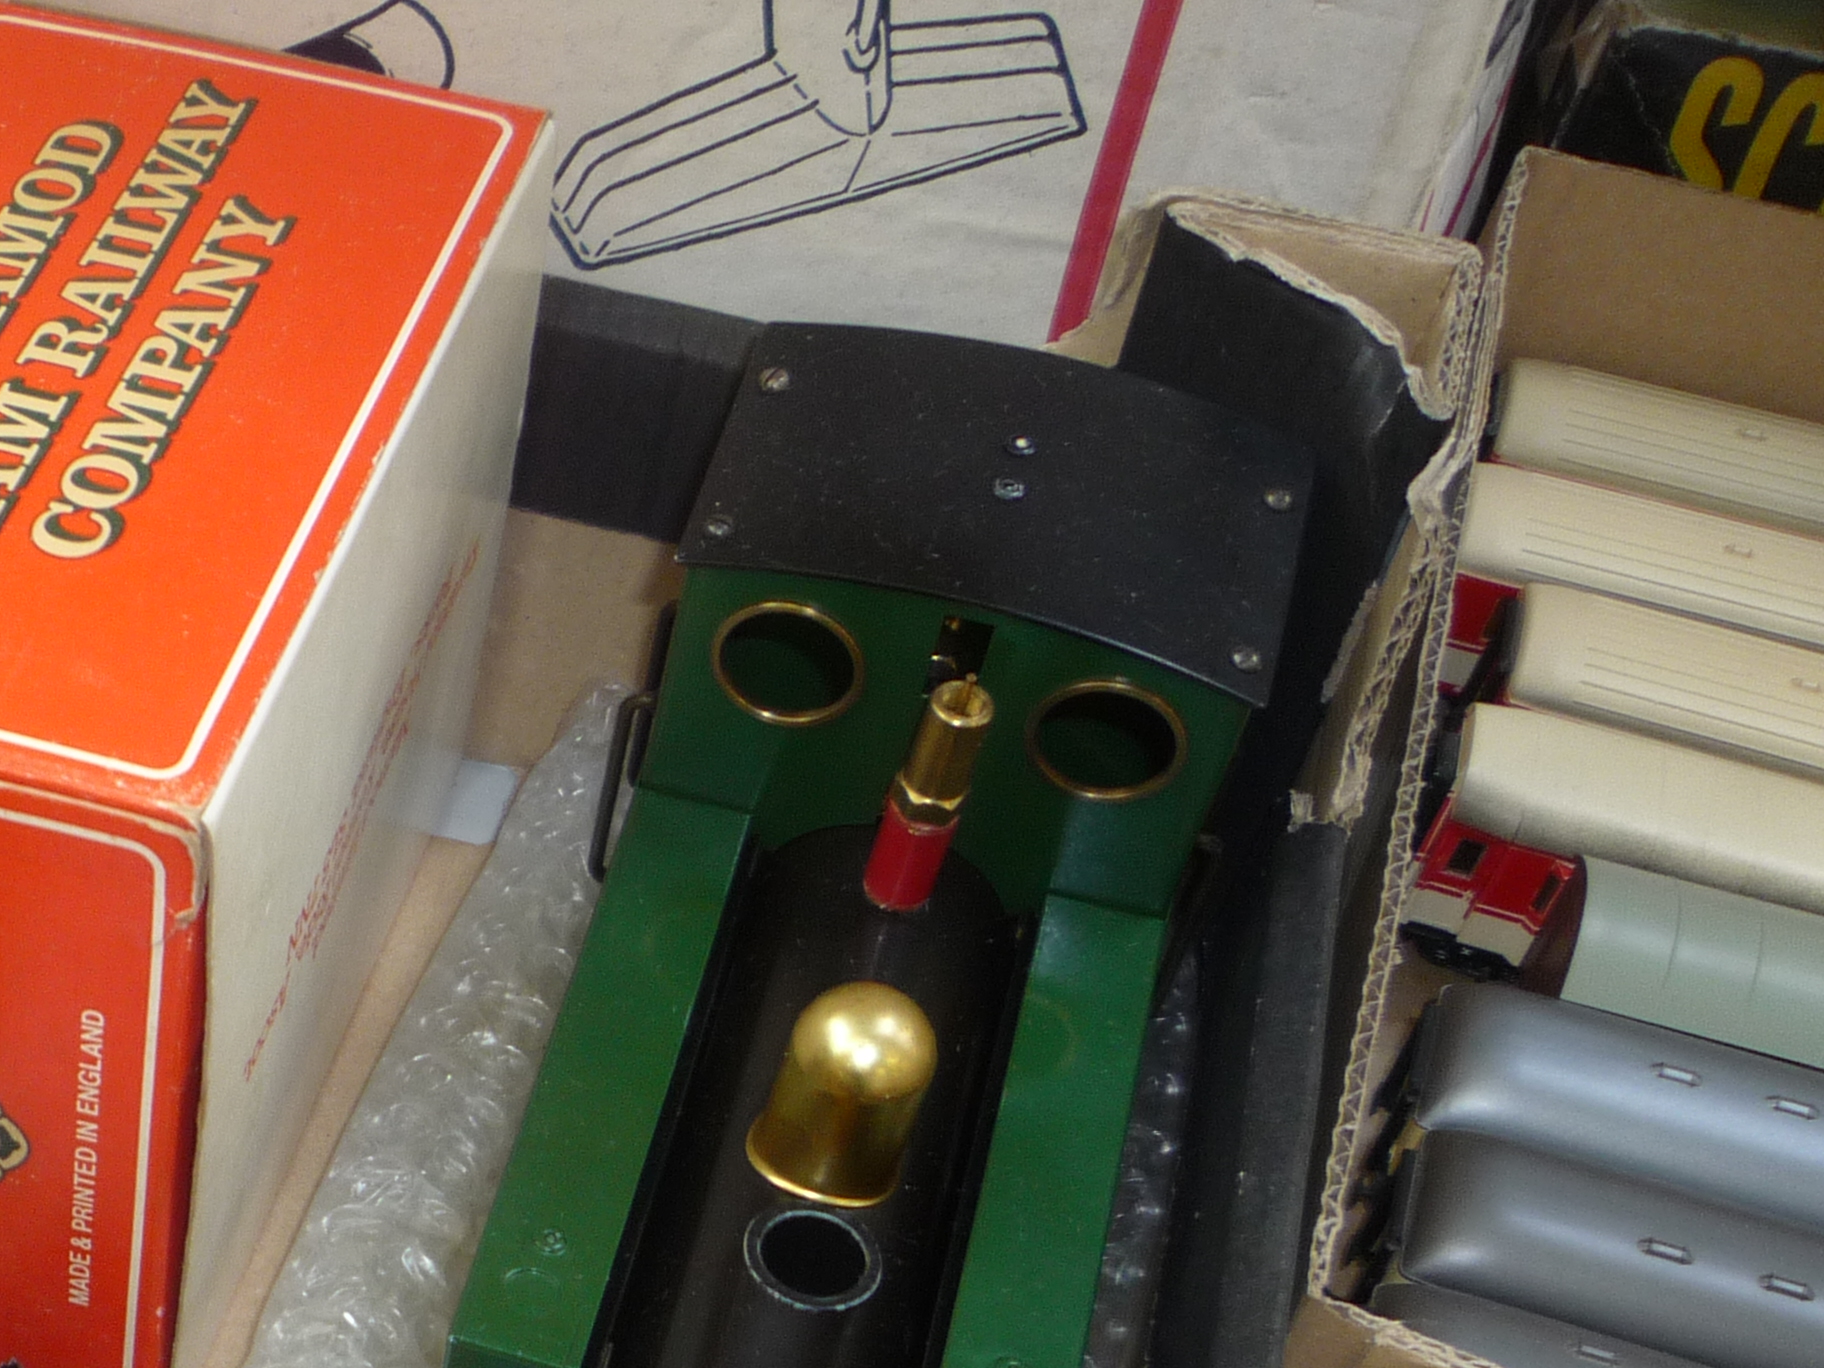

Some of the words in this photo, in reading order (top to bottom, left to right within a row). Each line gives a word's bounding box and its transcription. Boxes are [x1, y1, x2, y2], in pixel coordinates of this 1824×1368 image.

[16, 79, 259, 379] RAILWAY
[31, 196, 298, 559] COMPANY
[77, 1009, 105, 1117] ENGLAND
[76, 1119, 98, 1143] IN
[72, 1149, 98, 1233] PRINTED
[68, 1251, 91, 1307] MADE
[71, 1237, 92, 1250] &
